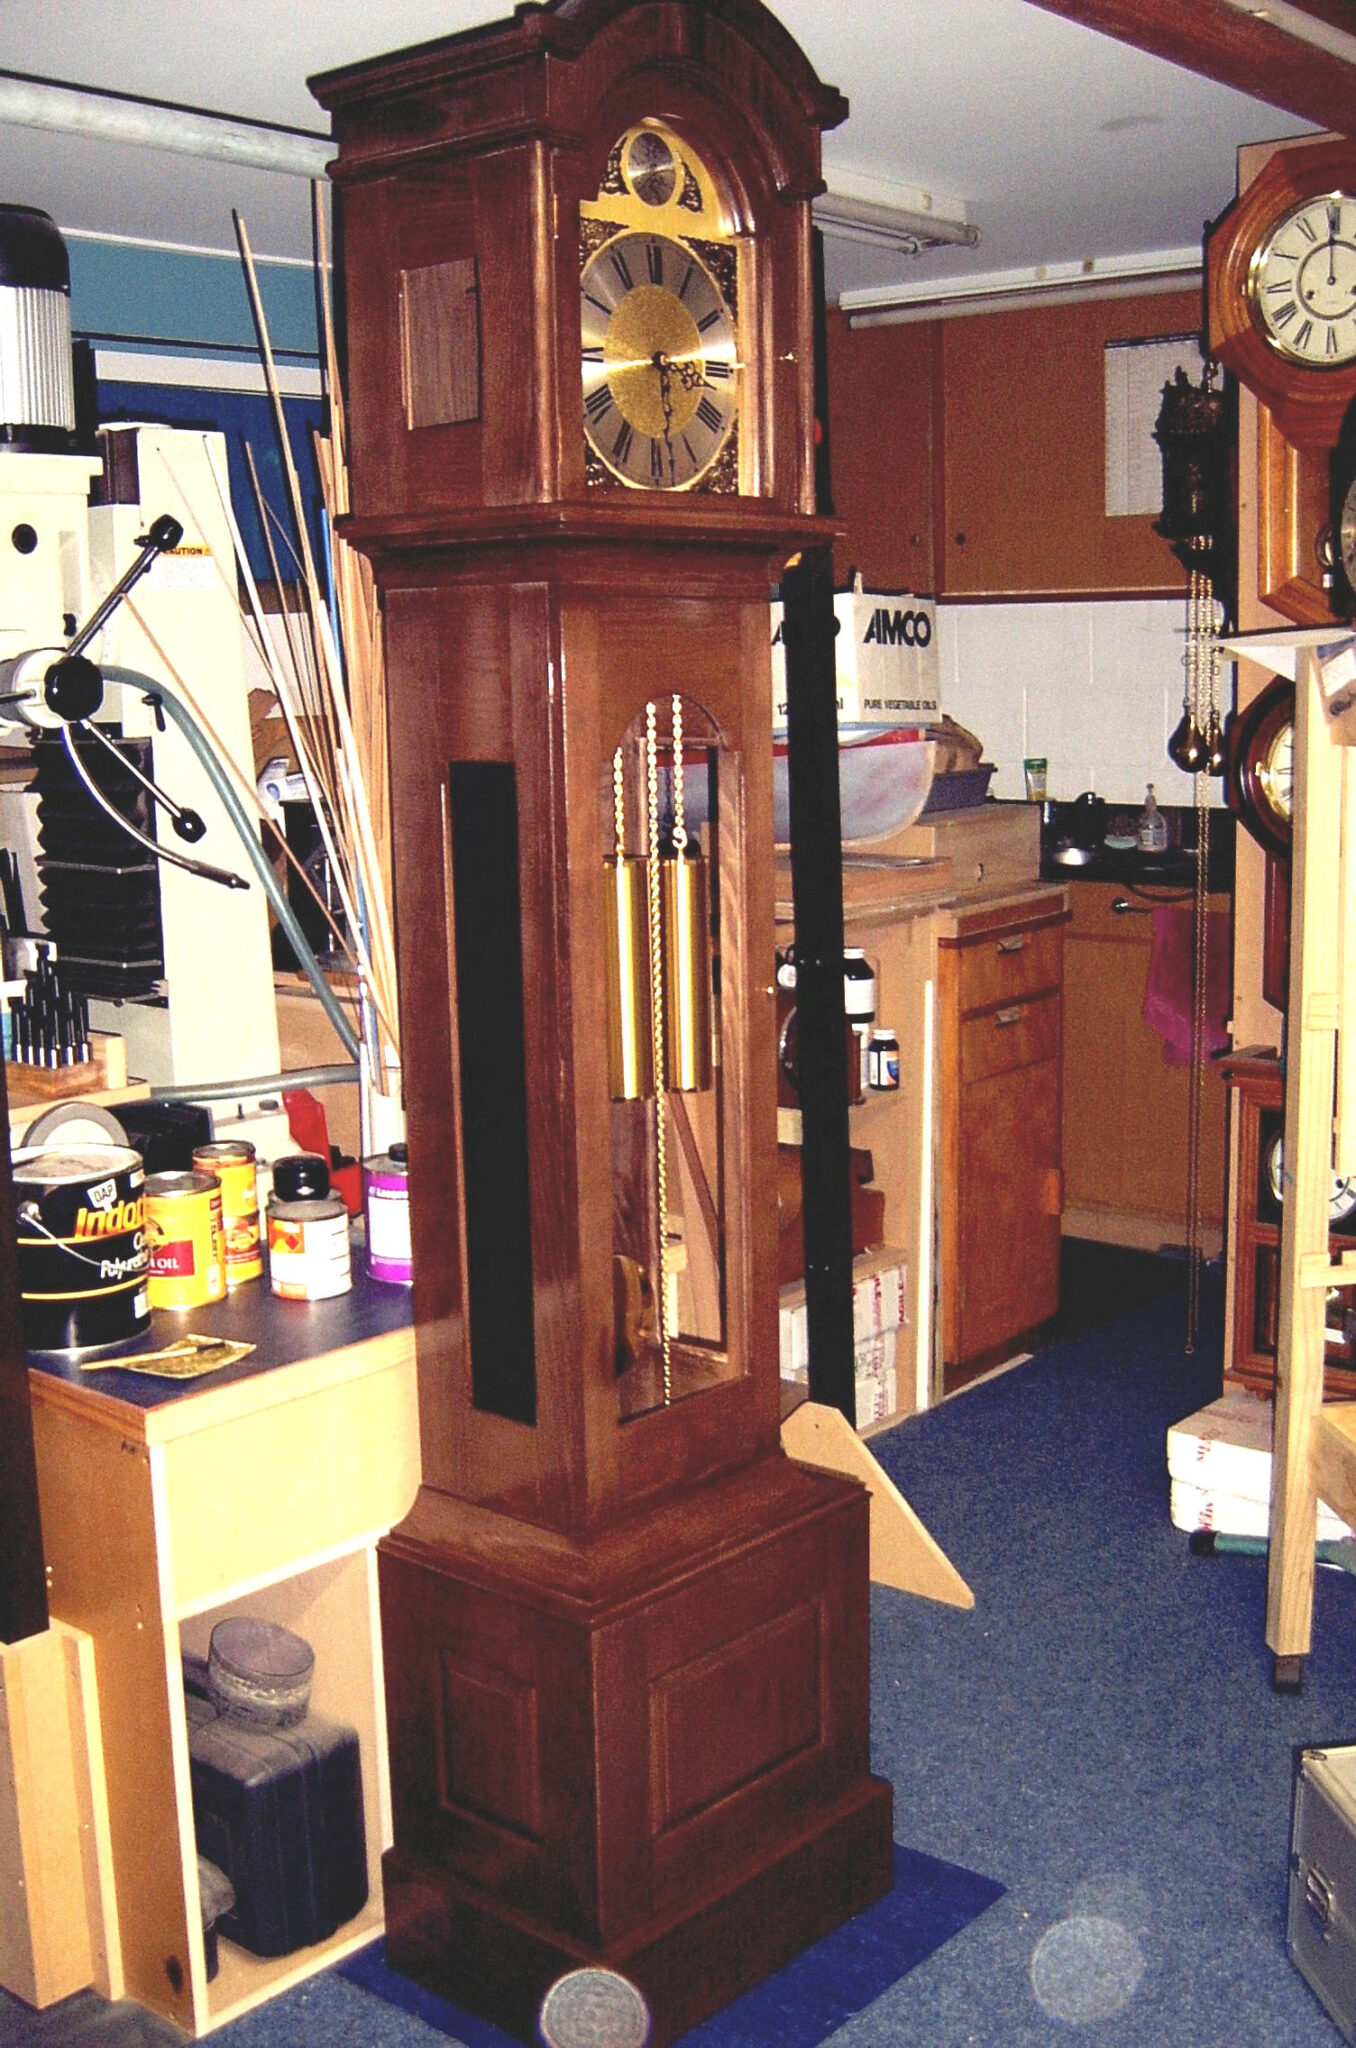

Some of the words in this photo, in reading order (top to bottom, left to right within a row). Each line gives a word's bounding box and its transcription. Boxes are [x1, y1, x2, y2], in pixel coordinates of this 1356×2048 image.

[863, 698, 882, 710] PURE
[884, 699, 920, 711] VEGETABLE
[93, 1184, 114, 1203] DAP
[156, 1257, 180, 1270] OIL
